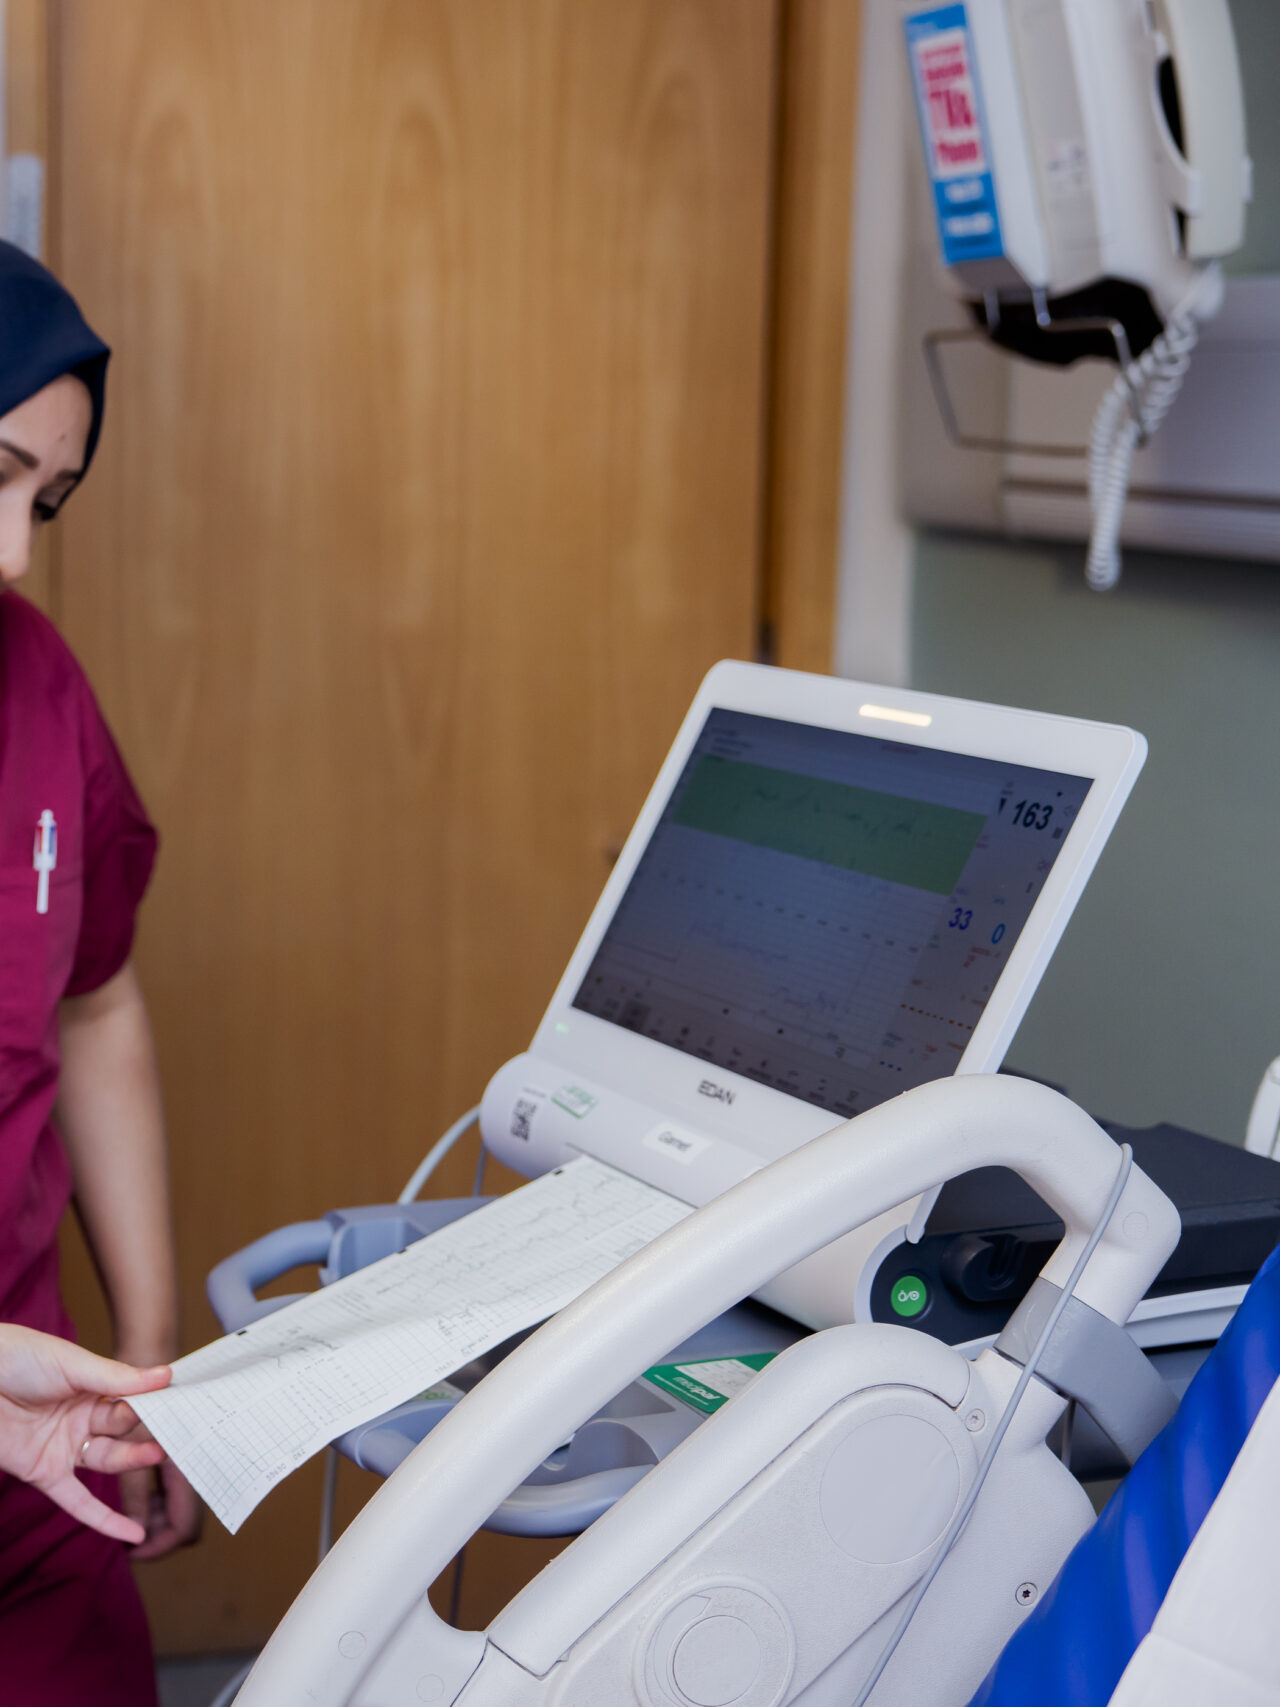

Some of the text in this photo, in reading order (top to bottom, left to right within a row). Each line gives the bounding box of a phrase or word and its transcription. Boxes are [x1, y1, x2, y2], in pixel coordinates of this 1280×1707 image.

[1012, 800, 1053, 831] 163
[948, 907, 974, 931] 33
[991, 923, 1006, 944] 0
[698, 1079, 736, 1105] EDAN
